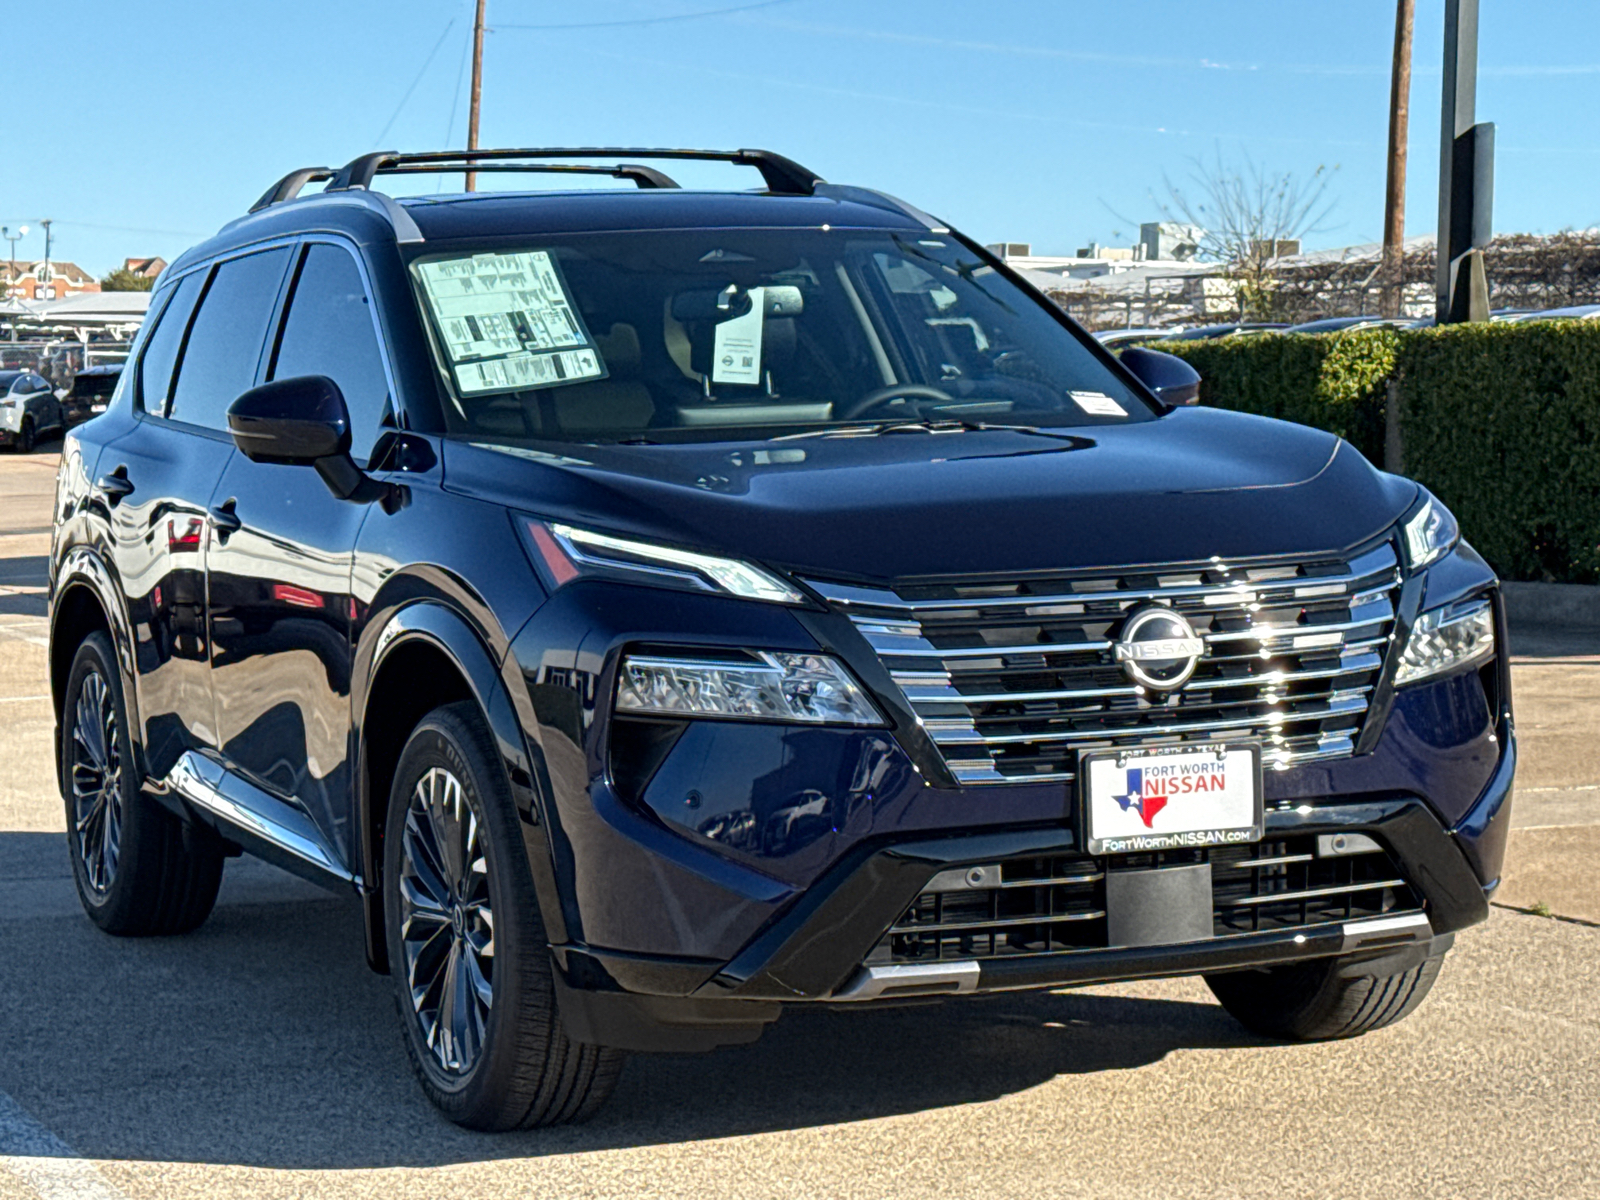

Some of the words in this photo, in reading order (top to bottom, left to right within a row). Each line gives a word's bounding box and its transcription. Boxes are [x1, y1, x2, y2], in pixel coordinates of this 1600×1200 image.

[1117, 641, 1200, 659] NISSAN
[1121, 749, 1145, 759] FORT
[1149, 747, 1183, 757] WORTH
[1196, 743, 1226, 753] TEXAS
[1144, 765, 1177, 777] FORT
[1179, 762, 1225, 775] WORTH
[1145, 773, 1225, 796] NISSAN
